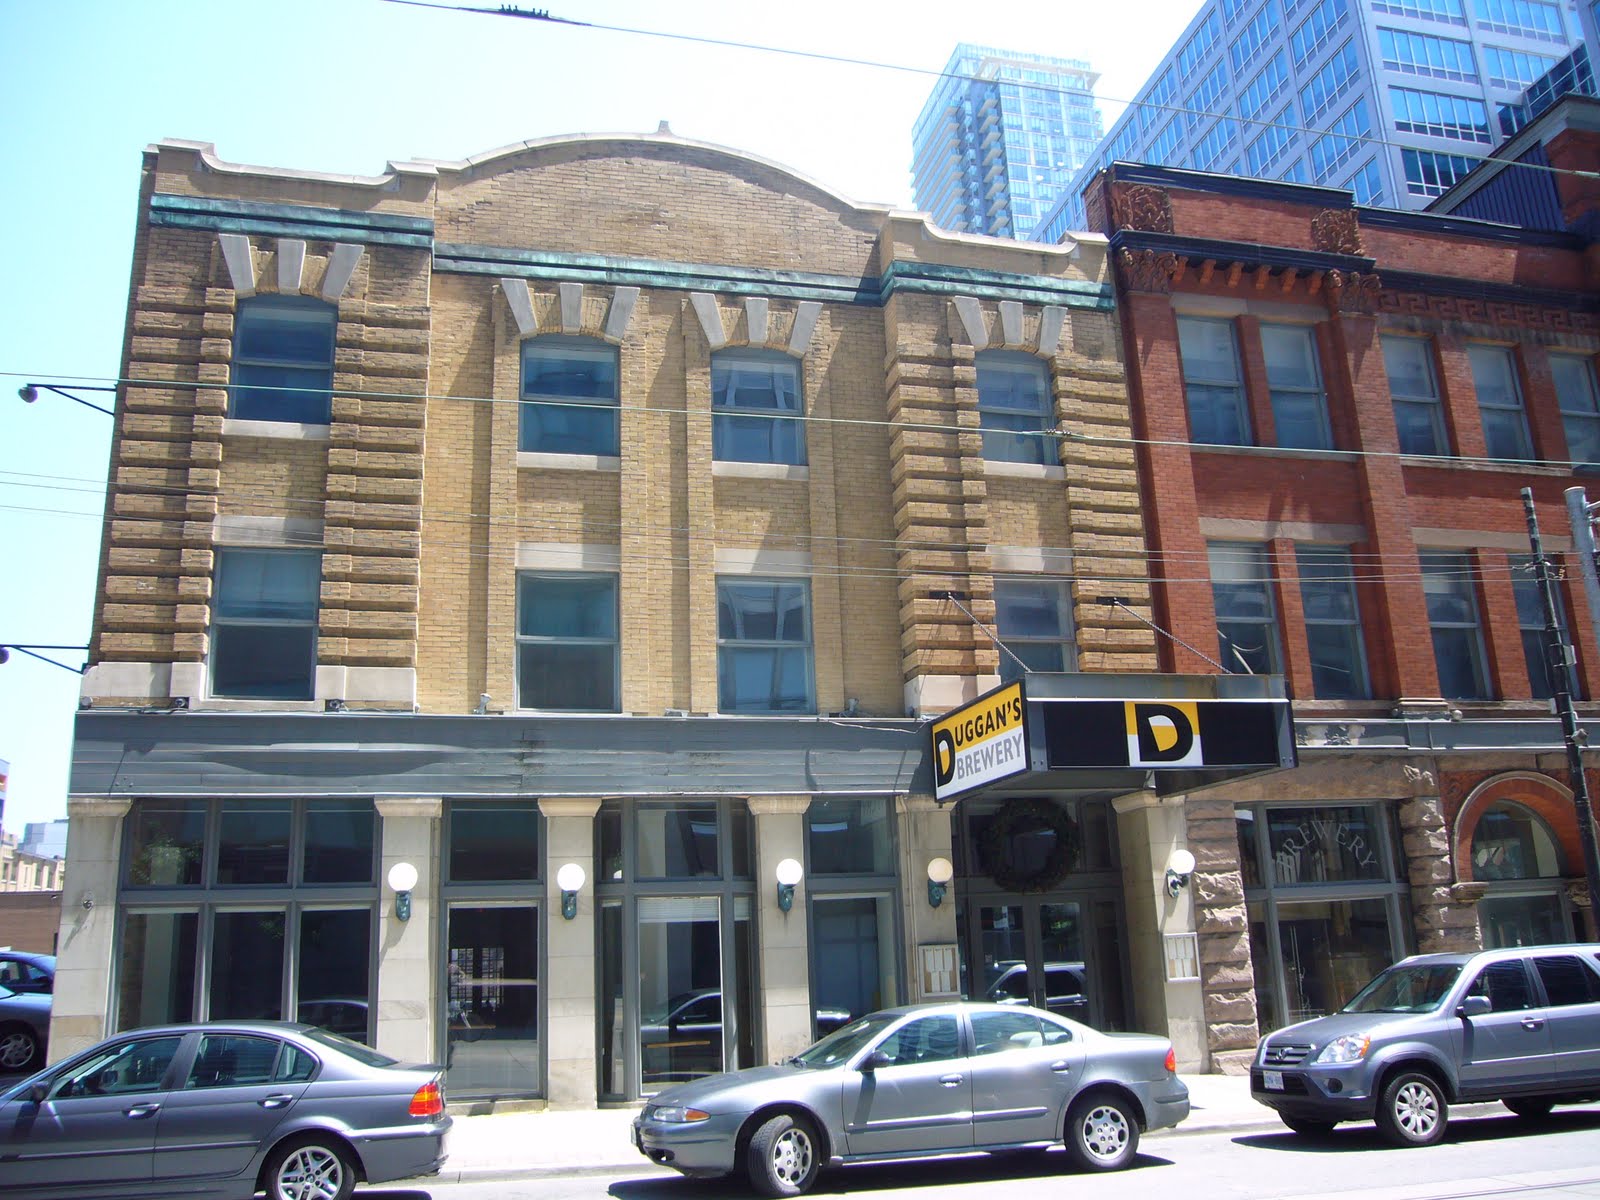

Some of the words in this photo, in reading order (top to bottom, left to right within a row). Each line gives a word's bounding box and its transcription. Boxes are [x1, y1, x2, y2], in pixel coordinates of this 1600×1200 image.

[934, 697, 1022, 788] DUGGAN'S
[956, 732, 1023, 780] BREWERY
[1134, 703, 1194, 763] D
